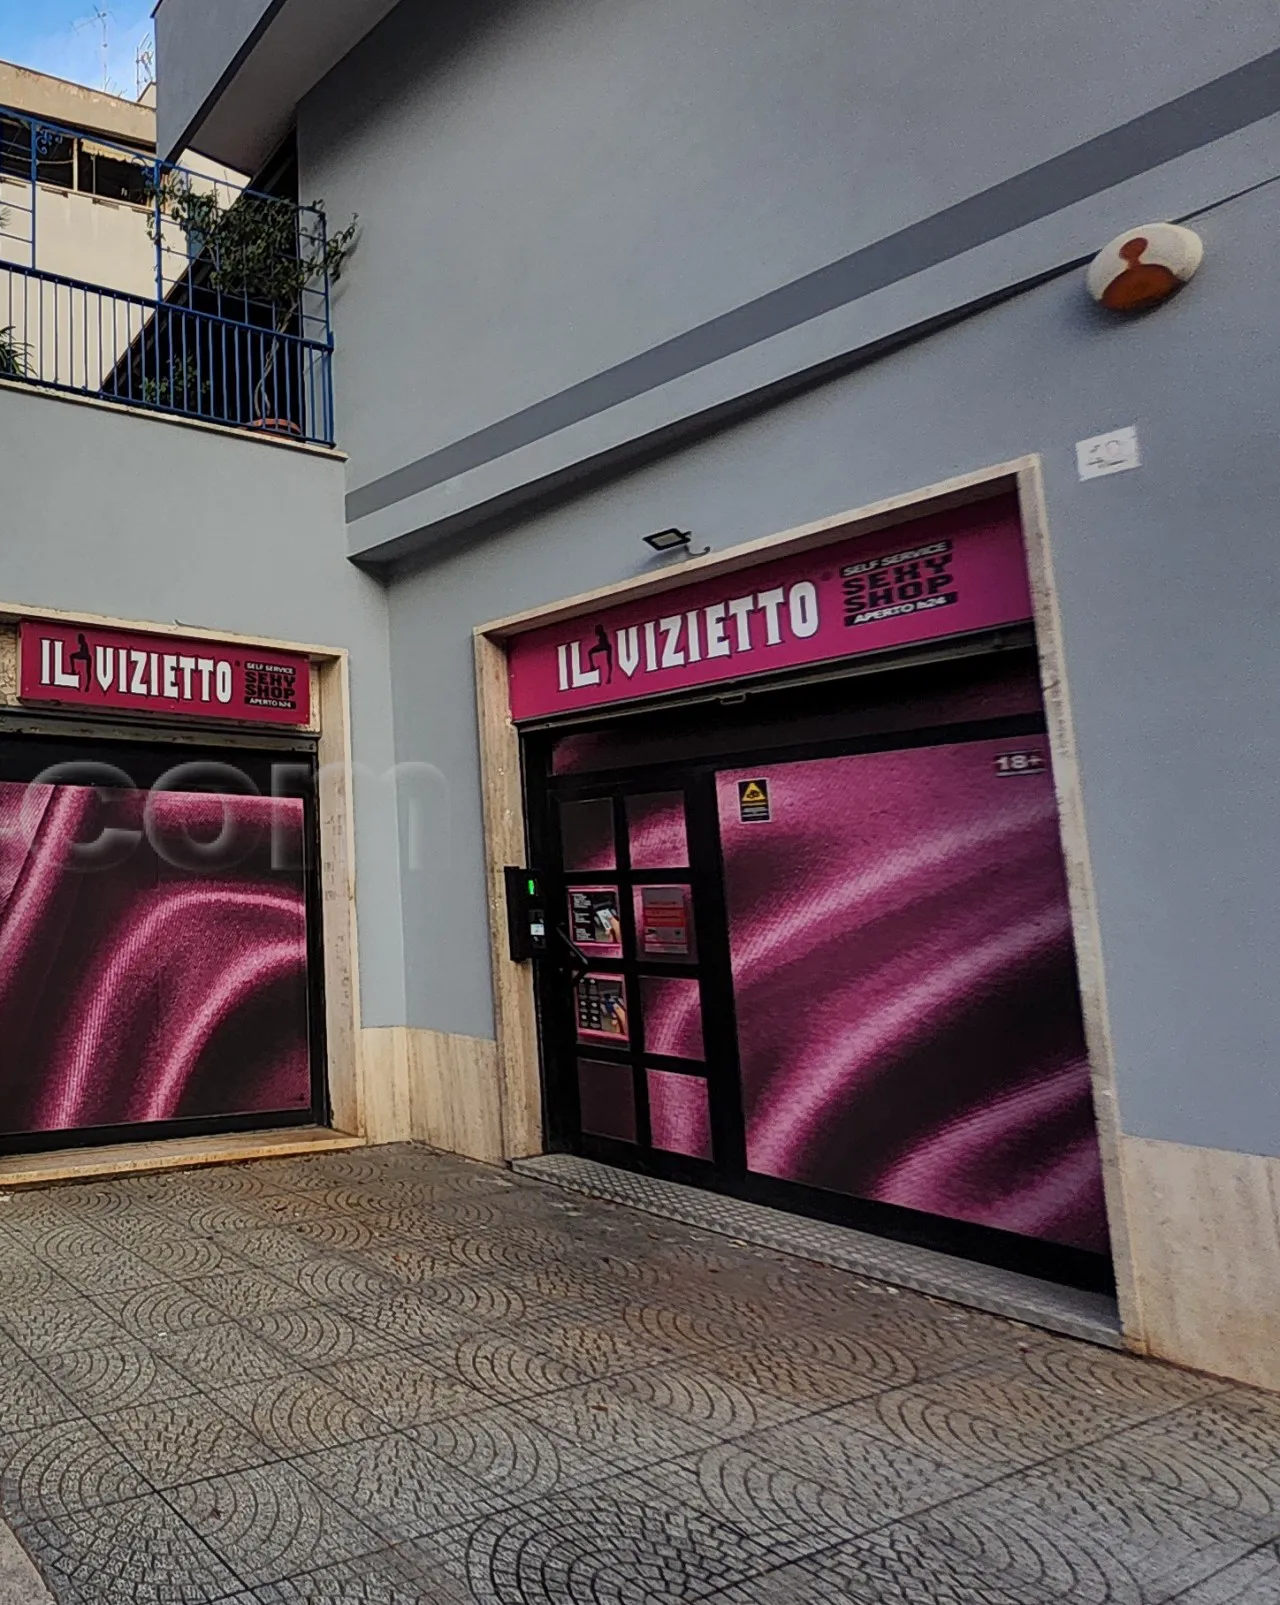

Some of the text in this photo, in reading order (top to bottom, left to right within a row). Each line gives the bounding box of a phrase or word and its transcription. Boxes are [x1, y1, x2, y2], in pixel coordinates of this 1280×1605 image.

[843, 541, 947, 576] SELF SERVICE
[842, 574, 954, 614] SHOP
[853, 603, 915, 624] APERTO
[557, 581, 819, 692] IL VIZIETTO
[40, 638, 232, 703] IL VIZIETTO
[246, 662, 293, 674] SELF SERVICE
[245, 683, 295, 700] SHOP
[249, 698, 278, 706] APERTO
[992, 755, 1044, 770] 18+
